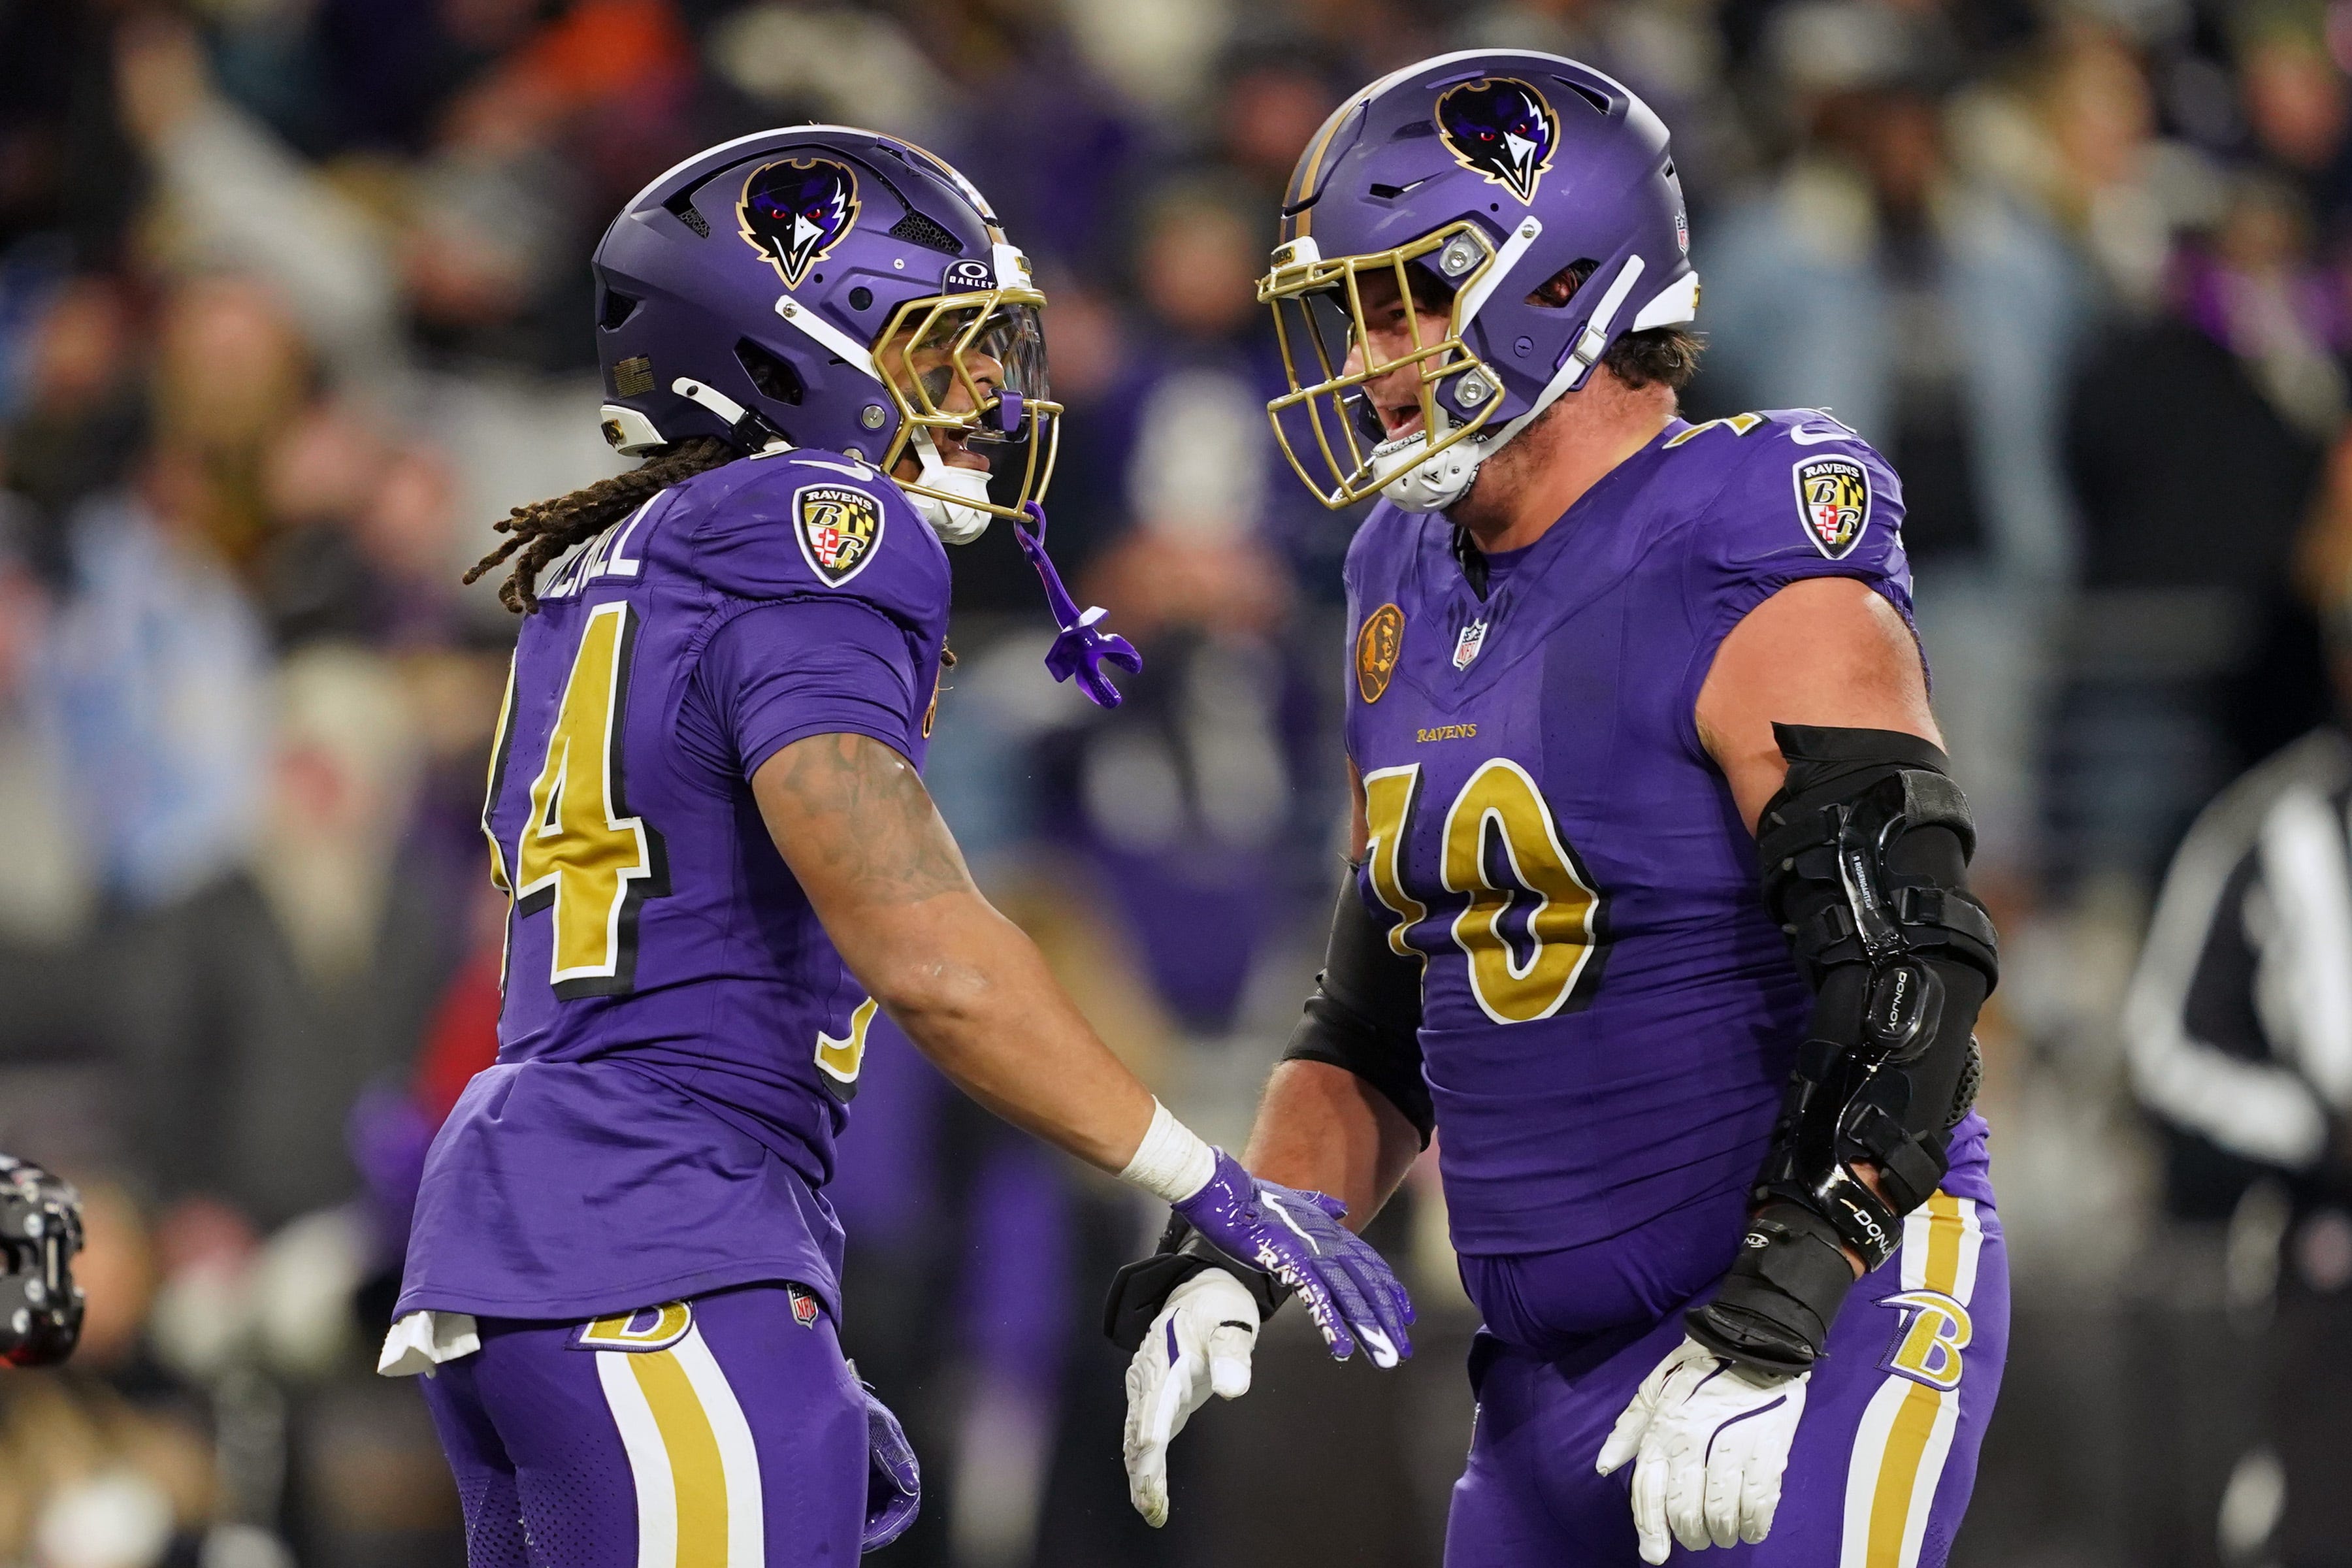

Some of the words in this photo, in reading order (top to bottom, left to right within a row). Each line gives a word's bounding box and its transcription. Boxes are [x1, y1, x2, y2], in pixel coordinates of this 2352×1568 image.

[949, 275, 996, 289] OAKLEY
[1803, 463, 1859, 478] RAVENS
[806, 490, 873, 511] RAVENS
[1805, 476, 1838, 505] B
[805, 501, 843, 528] B
[1837, 506, 1861, 536] R
[836, 534, 867, 563] R
[1416, 723, 1477, 743] RAVENS
[482, 600, 651, 984] 4
[1888, 972, 1908, 1031] DONJOY
[794, 1296, 815, 1318] NFL
[1879, 1291, 1972, 1387] B
